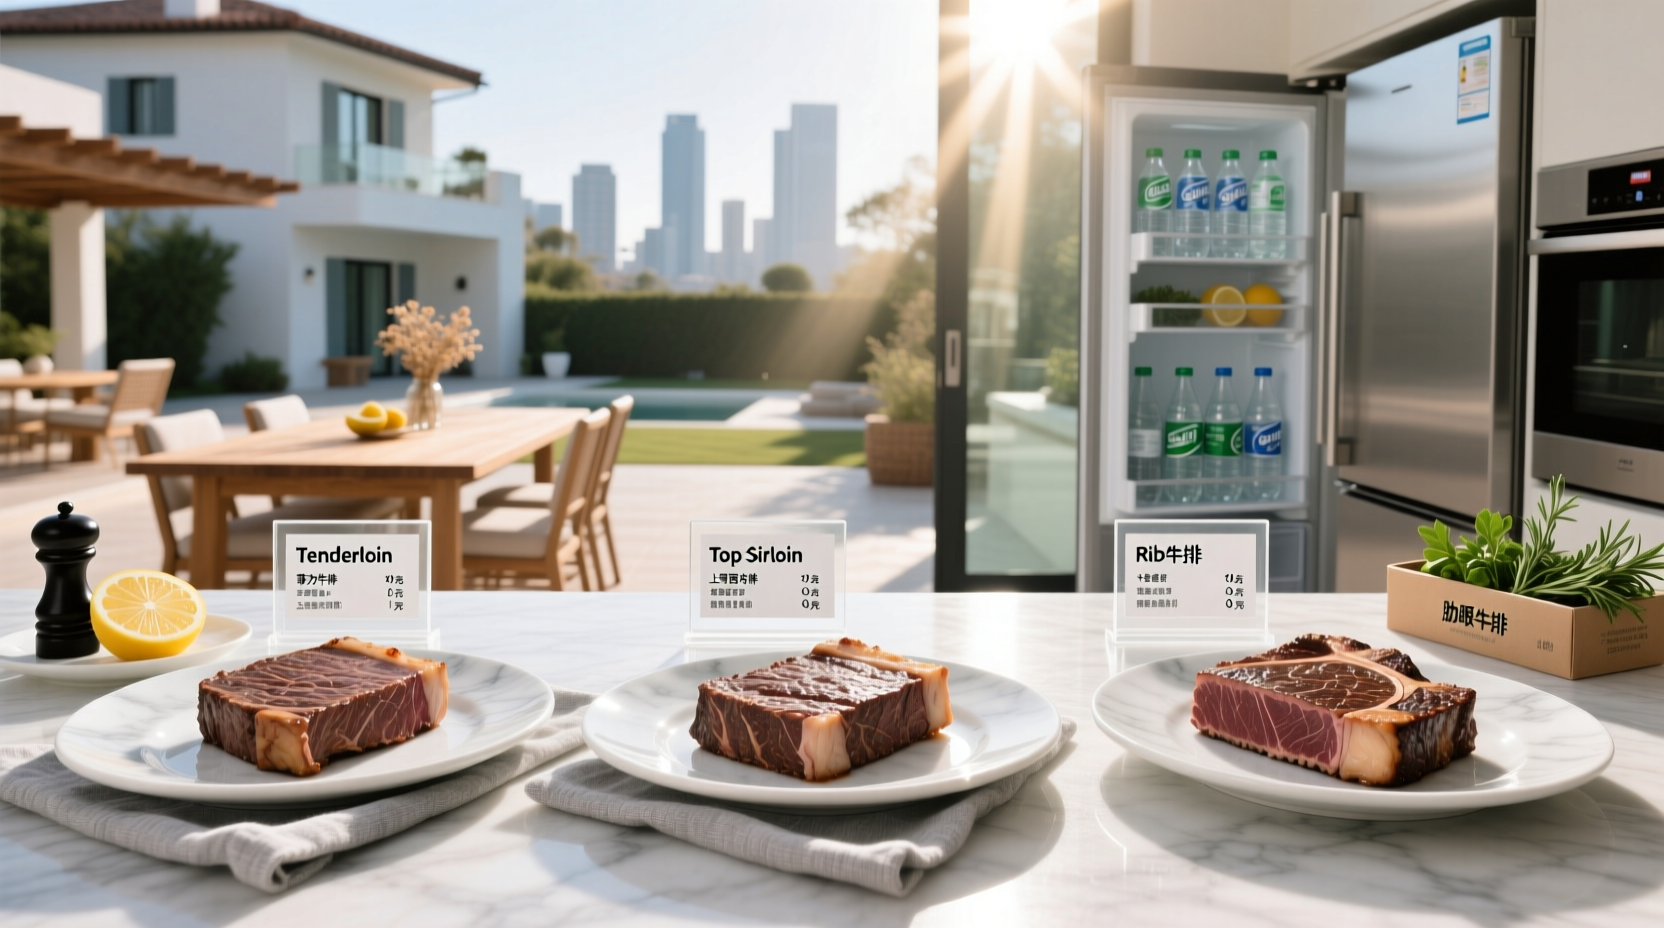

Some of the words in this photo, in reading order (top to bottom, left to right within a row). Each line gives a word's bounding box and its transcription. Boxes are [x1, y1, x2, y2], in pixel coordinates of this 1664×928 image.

[296, 546, 392, 563] Tenderloin
[709, 547, 742, 567] Top
[745, 546, 803, 563] Sirloin
[1136, 544, 1203, 564] Rib牛排
